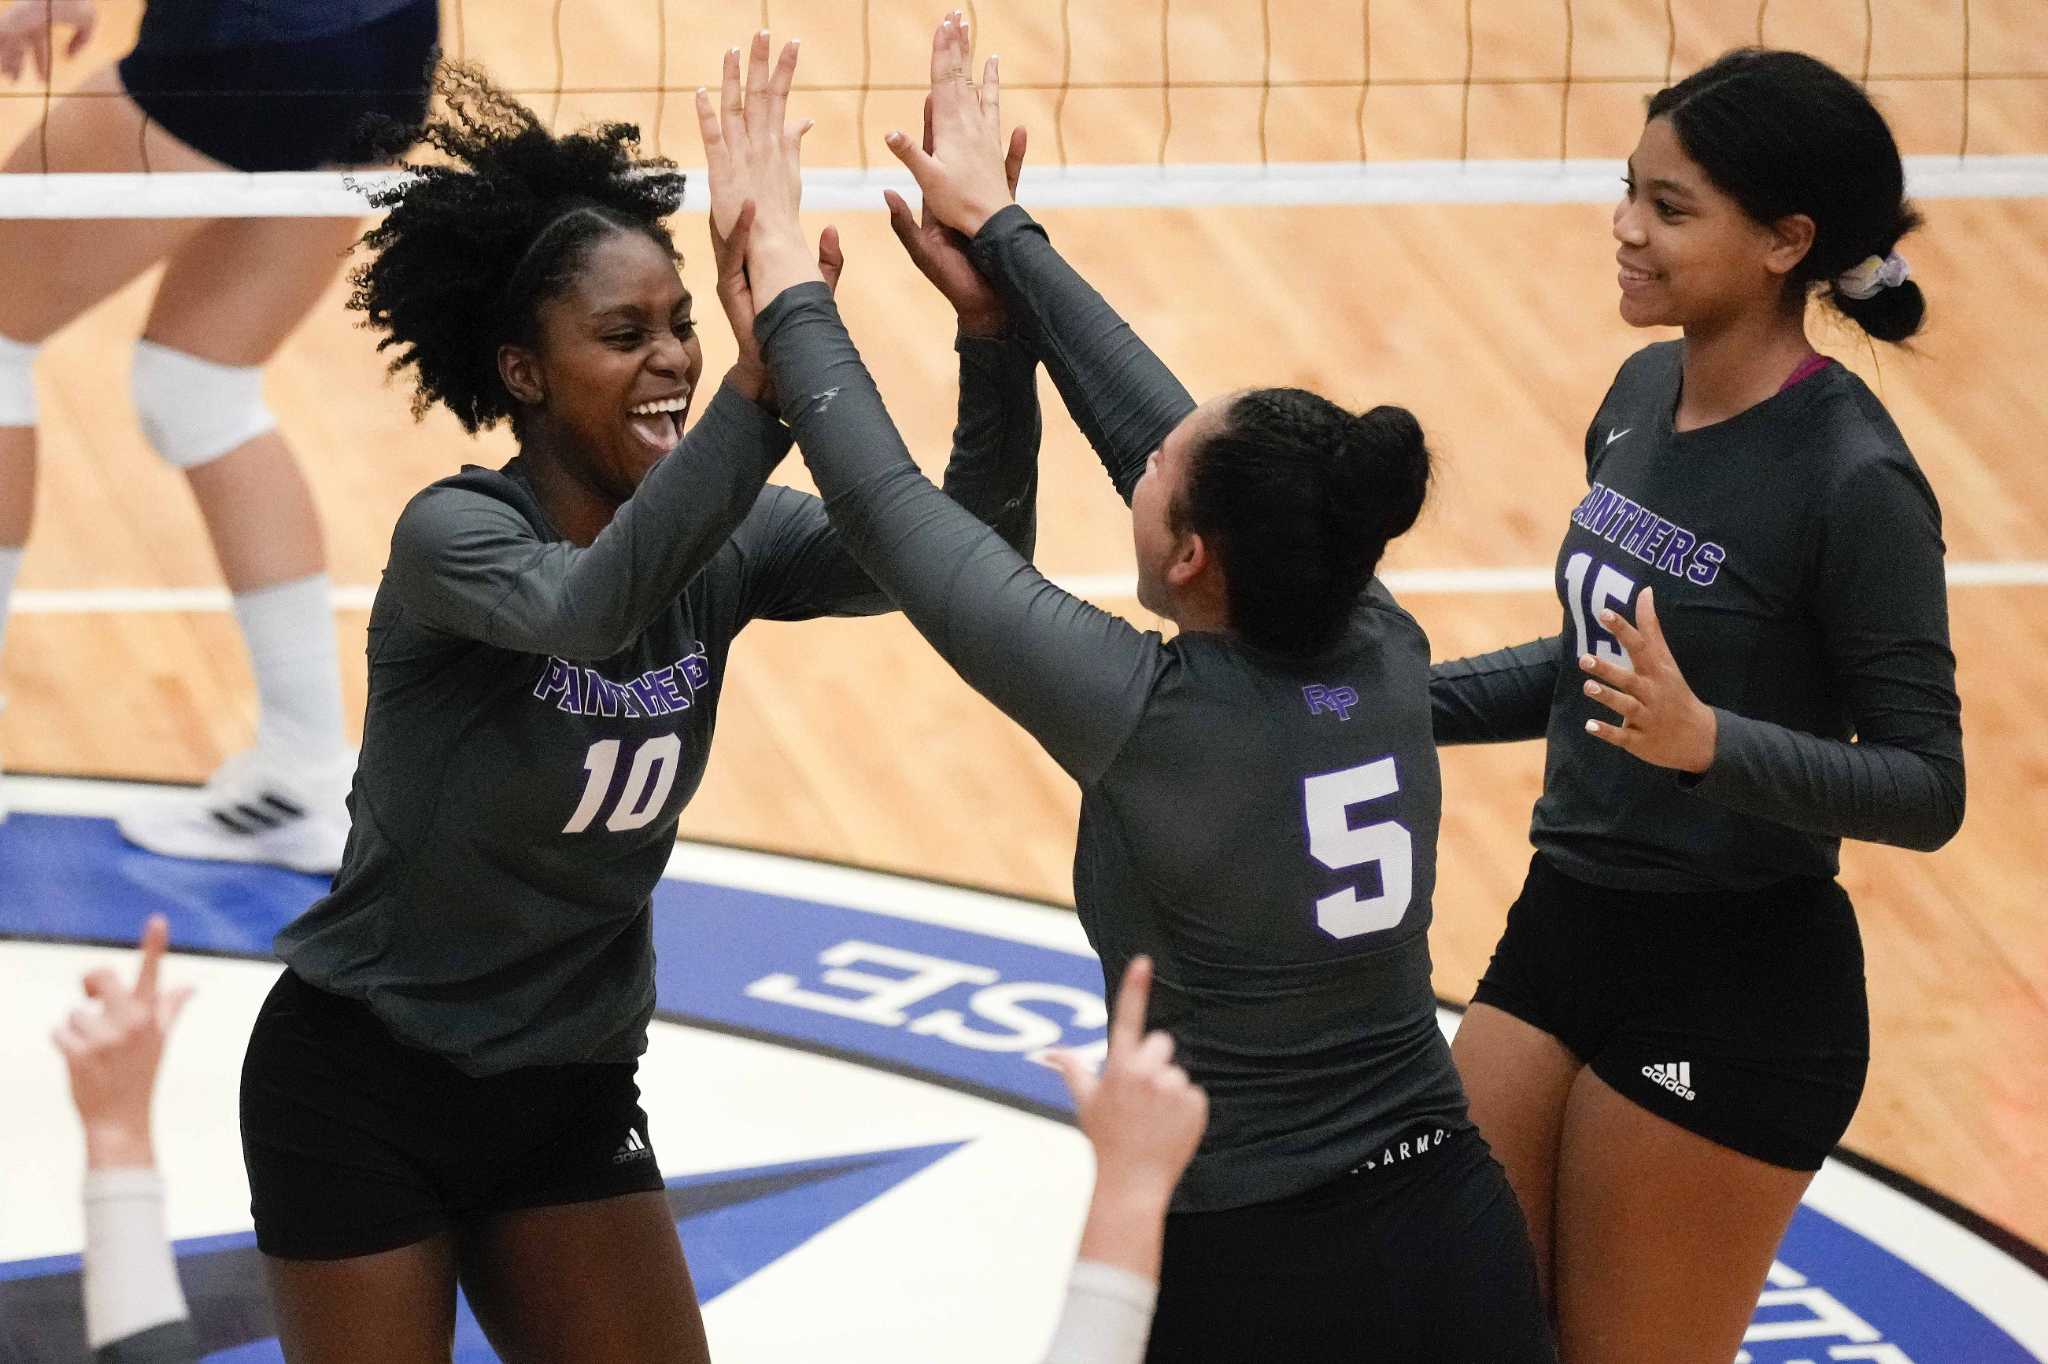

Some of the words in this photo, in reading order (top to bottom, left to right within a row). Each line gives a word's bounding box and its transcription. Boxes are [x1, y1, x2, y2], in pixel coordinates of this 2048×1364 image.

[1302, 684, 1359, 721] RP
[561, 732, 682, 834] 10
[1302, 754, 1413, 940] 5
[1641, 1065, 1696, 1101] adidas
[1383, 1129, 1451, 1166] ARMO
